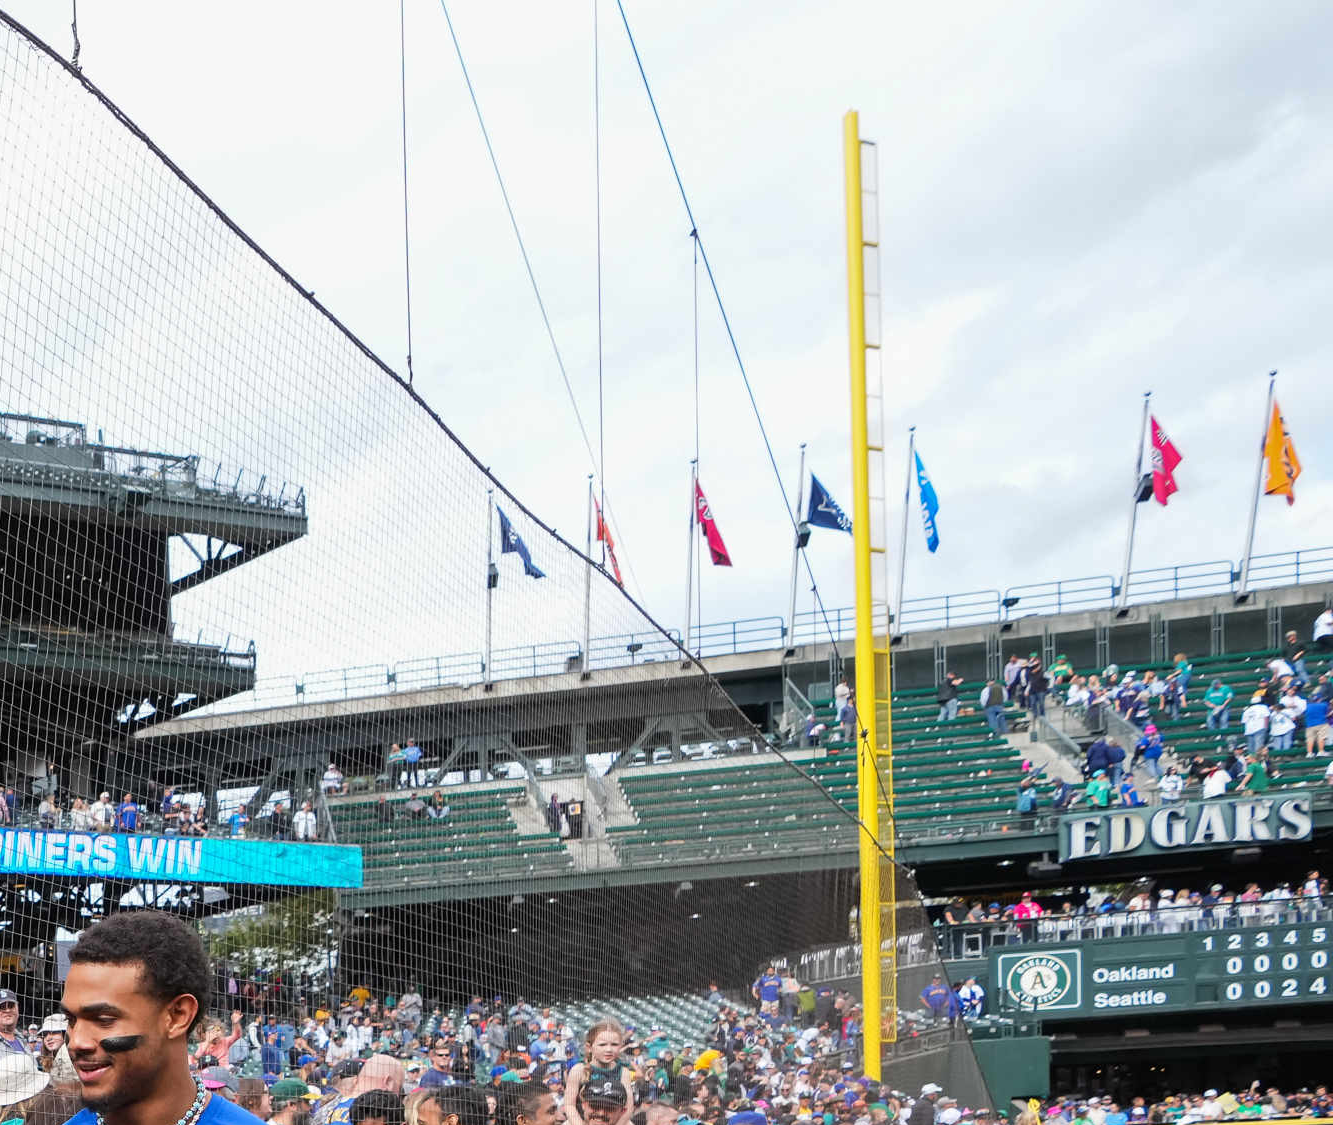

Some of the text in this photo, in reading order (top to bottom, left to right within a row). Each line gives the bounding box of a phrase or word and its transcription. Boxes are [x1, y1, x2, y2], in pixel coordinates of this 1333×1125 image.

[1068, 798, 1313, 861] EDGARS
[128, 836, 203, 875] WIN
[1202, 927, 1326, 951] 1 2 3 4 5
[1092, 950, 1329, 984] Oakland 0 0 0 0
[1093, 976, 1327, 1009] Seattle 0 0 2 4
